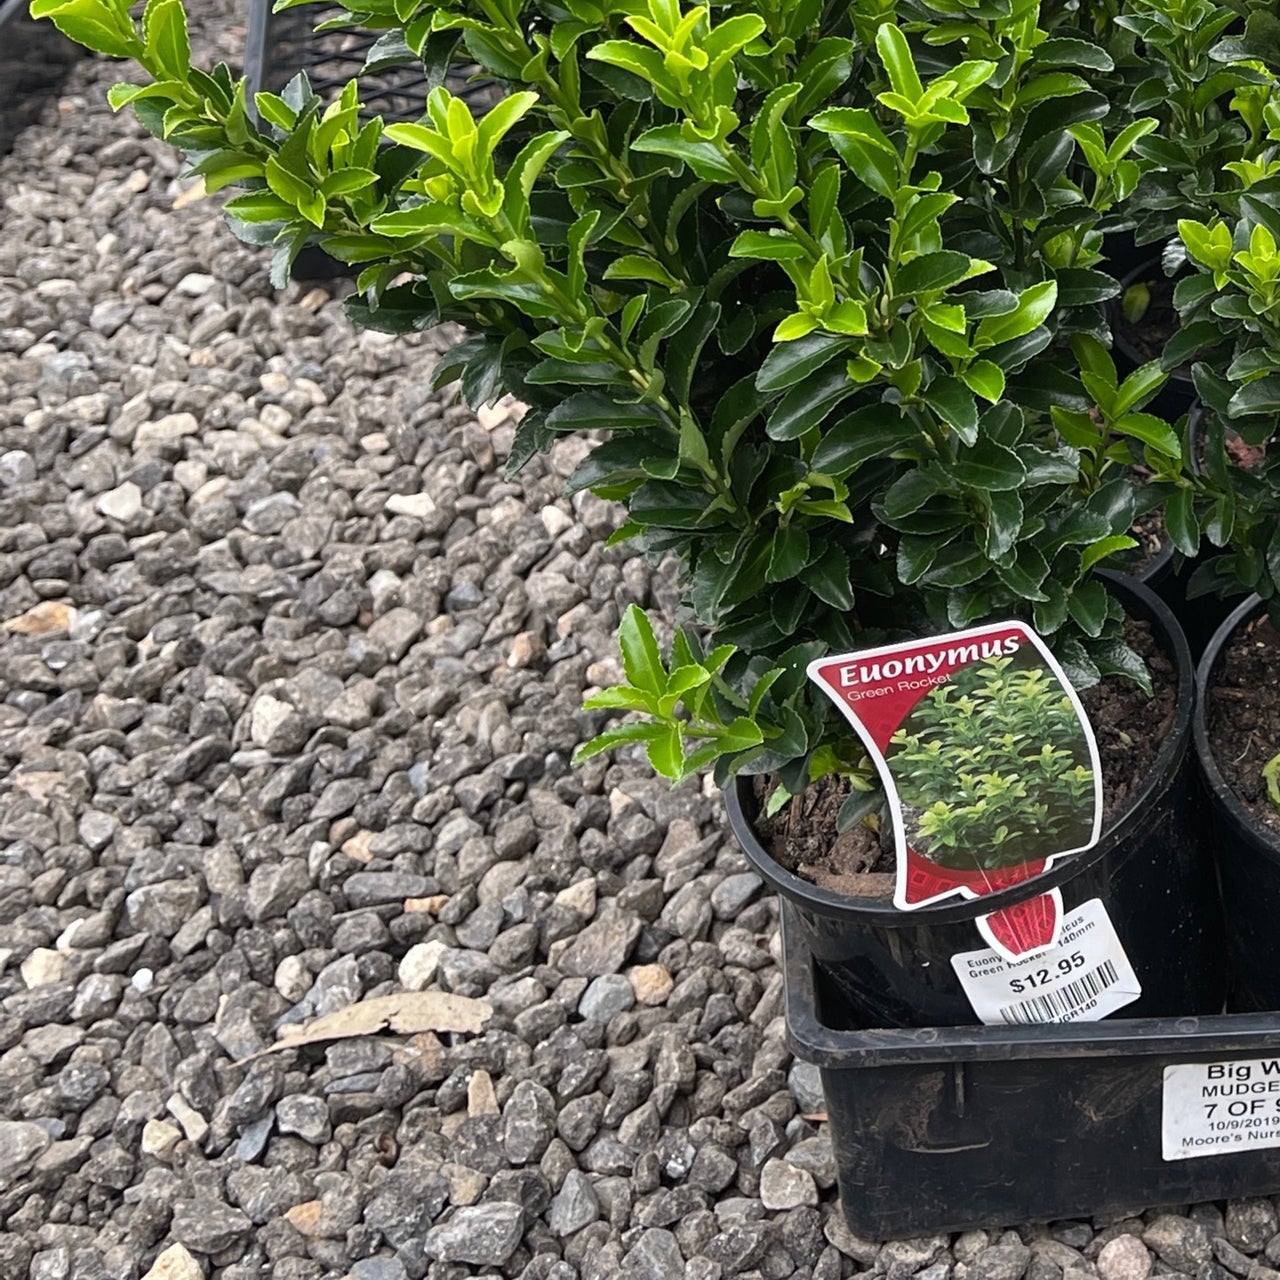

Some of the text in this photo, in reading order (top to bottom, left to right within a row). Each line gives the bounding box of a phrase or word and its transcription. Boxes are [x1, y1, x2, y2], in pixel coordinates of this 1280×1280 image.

[839, 635, 1020, 687] Euonymus
[847, 673, 953, 702] Green Rocket
[968, 964, 1004, 979] Green
[1057, 921, 1096, 948] 140mm
[967, 954, 1003, 969] Euony
[1009, 950, 1086, 994] $12.95
[1207, 1063, 1251, 1082] Big
[1204, 1104, 1219, 1119] 7
[1228, 1099, 1266, 1117] OF
[1208, 1116, 1280, 1132] 10/9/2019
[1182, 1132, 1243, 1148] Moore's
